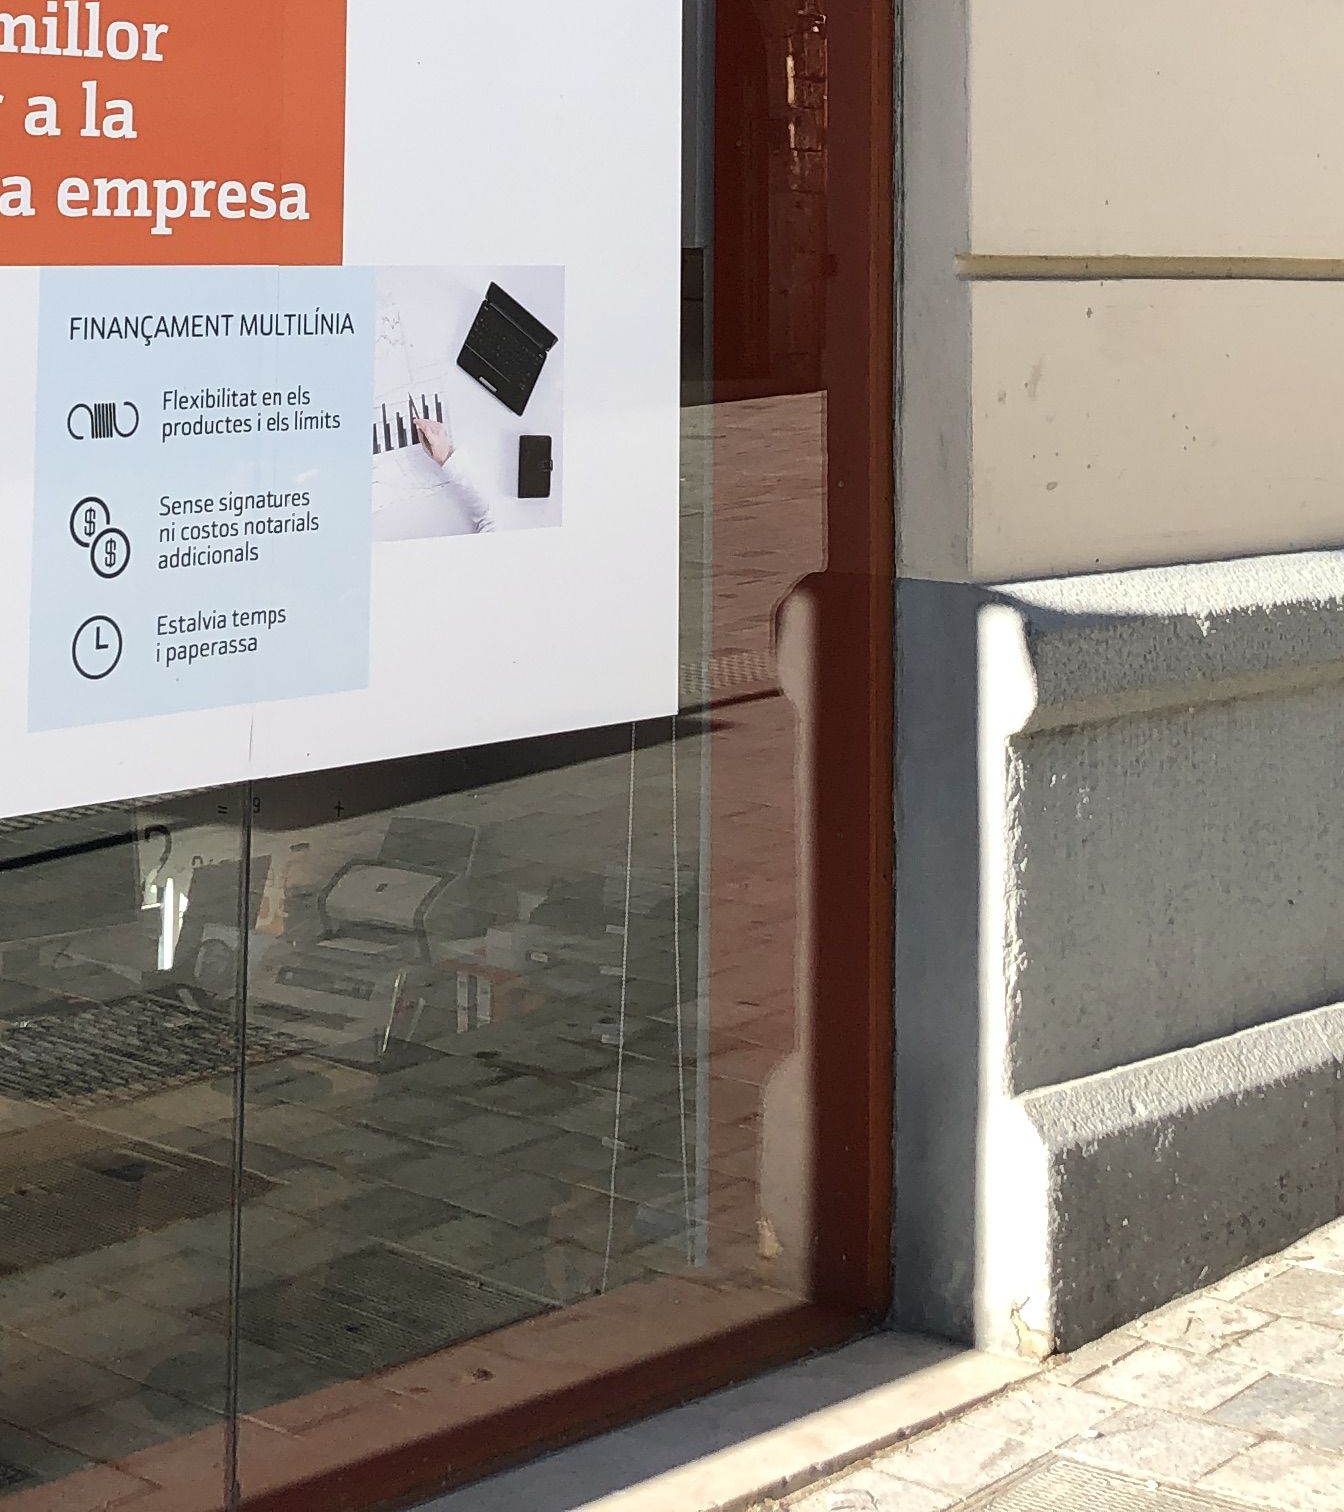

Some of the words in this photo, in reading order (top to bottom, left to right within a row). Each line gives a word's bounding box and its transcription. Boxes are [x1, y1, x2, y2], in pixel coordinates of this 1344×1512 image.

[24, 96, 61, 138] a
[80, 81, 138, 139] la
[57, 177, 310, 235] empresa
[69, 314, 234, 346] FINANÇAMENT
[240, 307, 355, 337] MULTILÍNIA
[162, 387, 257, 412] Flexibilitat
[261, 392, 282, 406] en
[287, 386, 311, 406] els
[162, 414, 252, 443] productes
[256, 412, 262, 432] i
[267, 411, 290, 432] els
[293, 409, 341, 431] límits
[159, 495, 214, 517] Sense
[218, 490, 310, 517] signatures
[159, 524, 176, 543] ni
[180, 521, 239, 541] costos
[244, 511, 320, 536] notarials
[158, 541, 259, 569] addicionals
[157, 610, 227, 636] Estalvia
[232, 607, 287, 631] temps
[156, 642, 161, 663] i
[166, 636, 258, 667] paperassa
